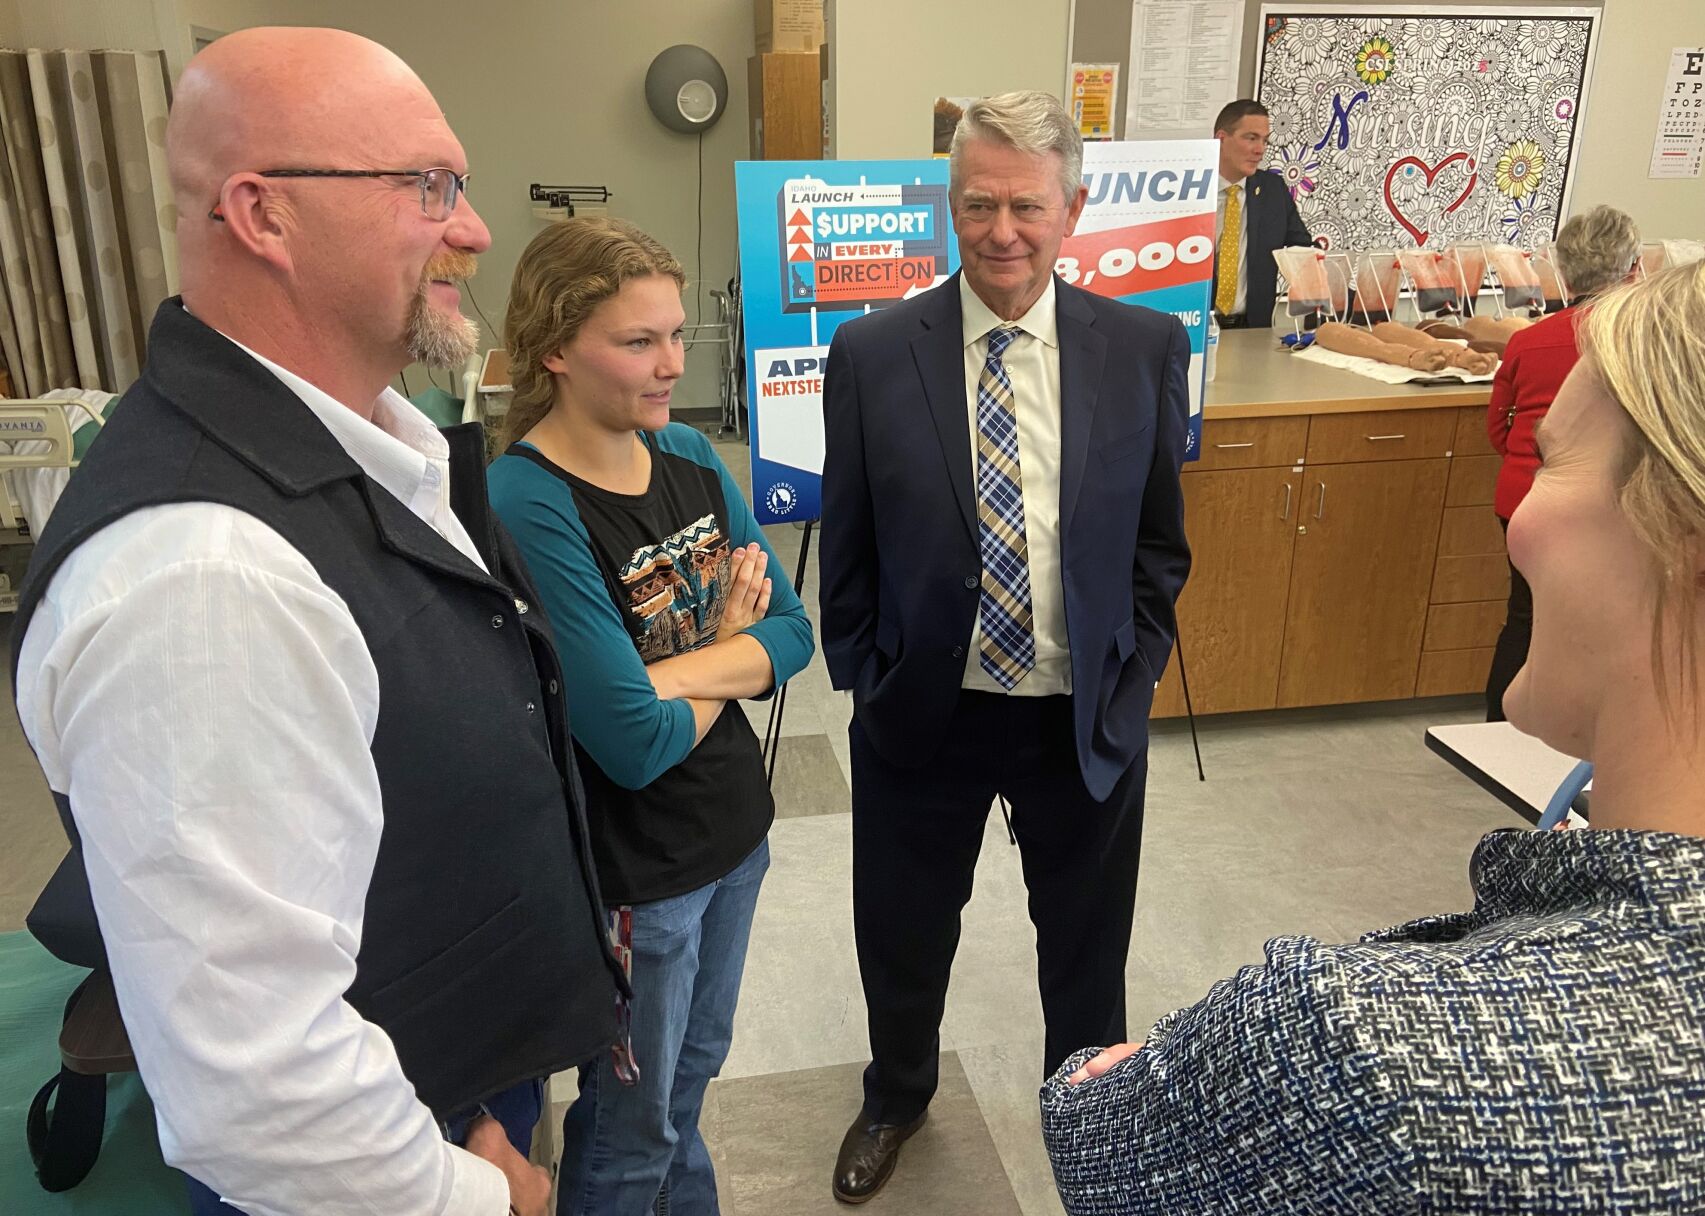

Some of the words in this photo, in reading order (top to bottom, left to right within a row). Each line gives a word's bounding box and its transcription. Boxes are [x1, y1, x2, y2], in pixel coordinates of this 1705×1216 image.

[1365, 58, 1390, 71] CSI
[1394, 58, 1450, 72] SPRING
[1683, 53, 1704, 75] E
[1314, 91, 1492, 176] Nursing
[791, 192, 854, 204] LAUNCH
[816, 211, 928, 238] $UPPORT
[1426, 196, 1502, 235] work
[816, 246, 829, 258] IN
[835, 244, 893, 257] EVERY
